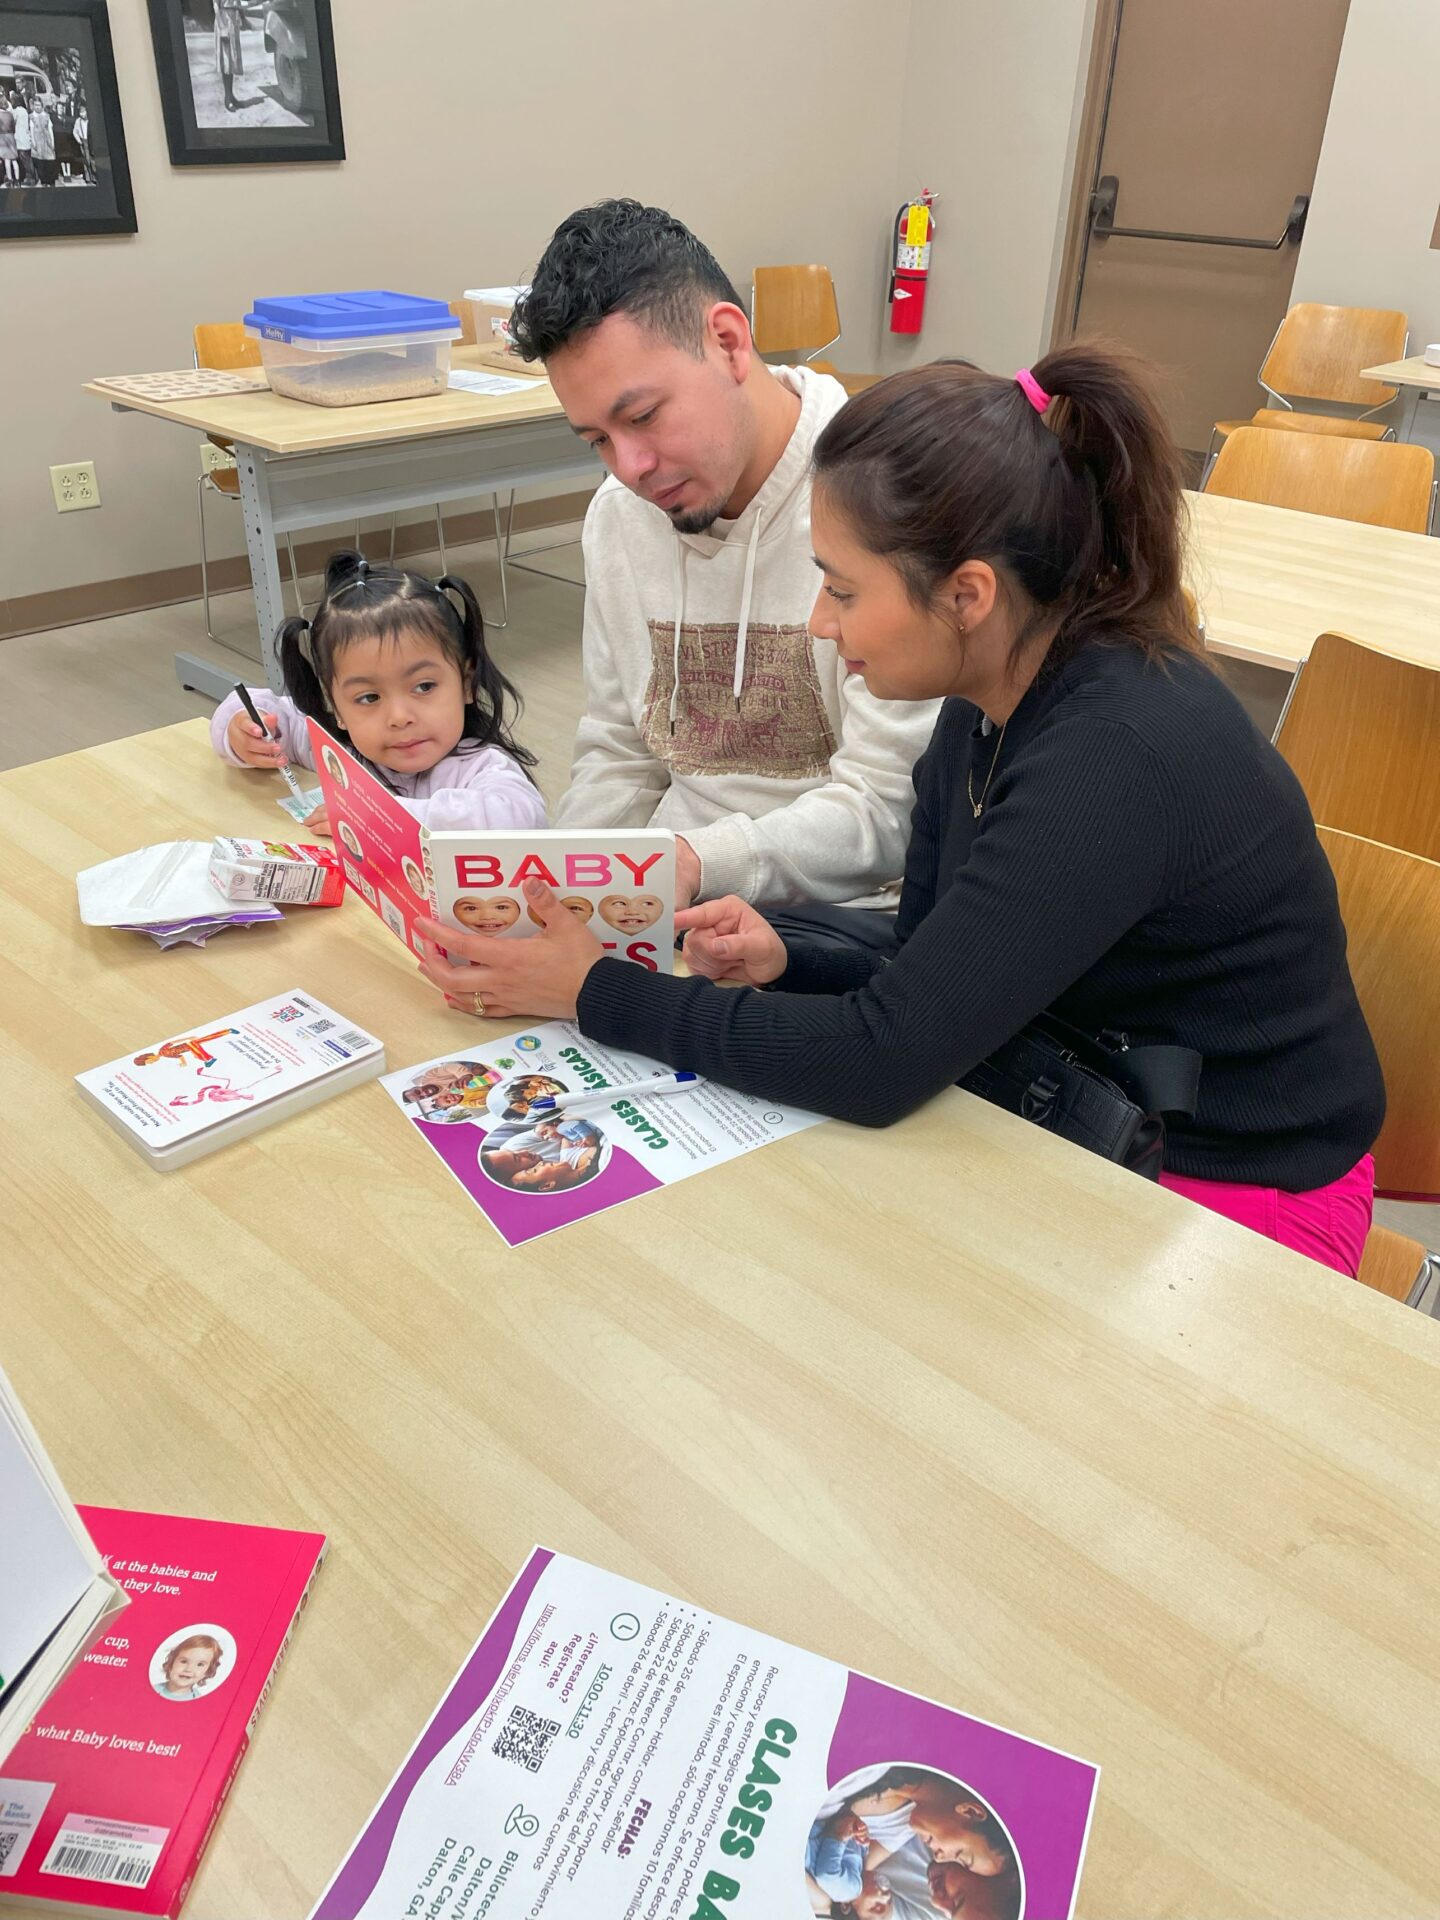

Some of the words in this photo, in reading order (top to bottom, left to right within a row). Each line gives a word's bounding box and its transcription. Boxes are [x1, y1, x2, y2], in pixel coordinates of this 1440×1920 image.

[662, 640, 697, 661] LVI
[701, 639, 765, 661] STRSS
[454, 853, 664, 888] BABY
[557, 1046, 612, 1089] ÁSICAS
[610, 1099, 668, 1149] CLASES
[112, 1560, 126, 1570] at
[127, 1561, 148, 1574] the
[149, 1563, 190, 1578] babies
[191, 1570, 218, 1582] and
[123, 1579, 152, 1594] they
[152, 1581, 182, 1596] love.
[104, 1636, 130, 1649] cup,
[643, 1610, 667, 1647] Sábado
[658, 1616, 682, 1653] Sábado
[671, 1621, 694, 1658] Sábado
[686, 1628, 710, 1665] Sábado
[83, 1653, 128, 1667] weater.
[271, 1637, 290, 1677] BABY
[538, 1640, 558, 1668] aquí:
[546, 1633, 582, 1688] Regístrate
[558, 1631, 598, 1703] ¿Interesado?
[630, 1660, 642, 1674] de
[637, 1647, 650, 1660] 26
[651, 1653, 665, 1667] 22
[664, 1658, 677, 1672] 22
[735, 1653, 747, 1664] El
[618, 1674, 634, 1699] abril
[645, 1667, 657, 1680] de
[657, 1672, 670, 1686] de
[673, 1680, 685, 1693] de
[680, 1666, 693, 1680] 25
[719, 1663, 740, 1703] espacio
[733, 1659, 760, 1712] emocional
[752, 1665, 779, 1711] Recursos
[250, 1679, 272, 1728] LOVES
[564, 1662, 613, 1739] 10:00-11:30
[629, 1681, 649, 1716] marzo:
[638, 1686, 665, 1726] febrero:
[712, 1703, 723, 1717] es
[729, 1711, 739, 1720] y
[36, 1725, 70, 1741] what
[71, 1729, 108, 1749] Baby
[108, 1735, 145, 1752] loves
[145, 1742, 182, 1757] best!
[594, 1705, 621, 1746] Lectura
[691, 1717, 720, 1763] limitado,
[711, 1720, 735, 1767] cerebral
[598, 1716, 634, 1777] Explorando
[618, 1727, 645, 1765] Contar,
[637, 1730, 663, 1767] Hablar,
[723, 1720, 754, 1783] estrategias
[564, 1754, 595, 1805] discusión
[599, 1766, 624, 1812] agrupar
[619, 1769, 643, 1807] cantar,
[681, 1763, 697, 1789] sólo
[719, 1717, 797, 1859] CLASES
[556, 1806, 569, 1822] de
[575, 1787, 599, 1824] través
[686, 1767, 717, 1825] temprano.
[701, 1782, 728, 1838] gratuitos
[566, 1824, 581, 1845] del
[600, 1809, 624, 1854] señalar
[617, 1798, 652, 1857] FECHAS:
[652, 1789, 686, 1857] aceptamos
[678, 1827, 692, 1844] Se
[417, 1836, 457, 1889] Dalton,
[447, 1845, 475, 1882] Calle
[532, 1823, 560, 1870] cuentos
[565, 1821, 598, 1882] comparar
[660, 1845, 682, 1885] ofrece
[688, 1837, 706, 1868] para
[530, 1843, 570, 1916] movimiento
[645, 1859, 659, 1873] 10
[404, 1894, 424, 1915] GA
[669, 1868, 693, 1914] padres
